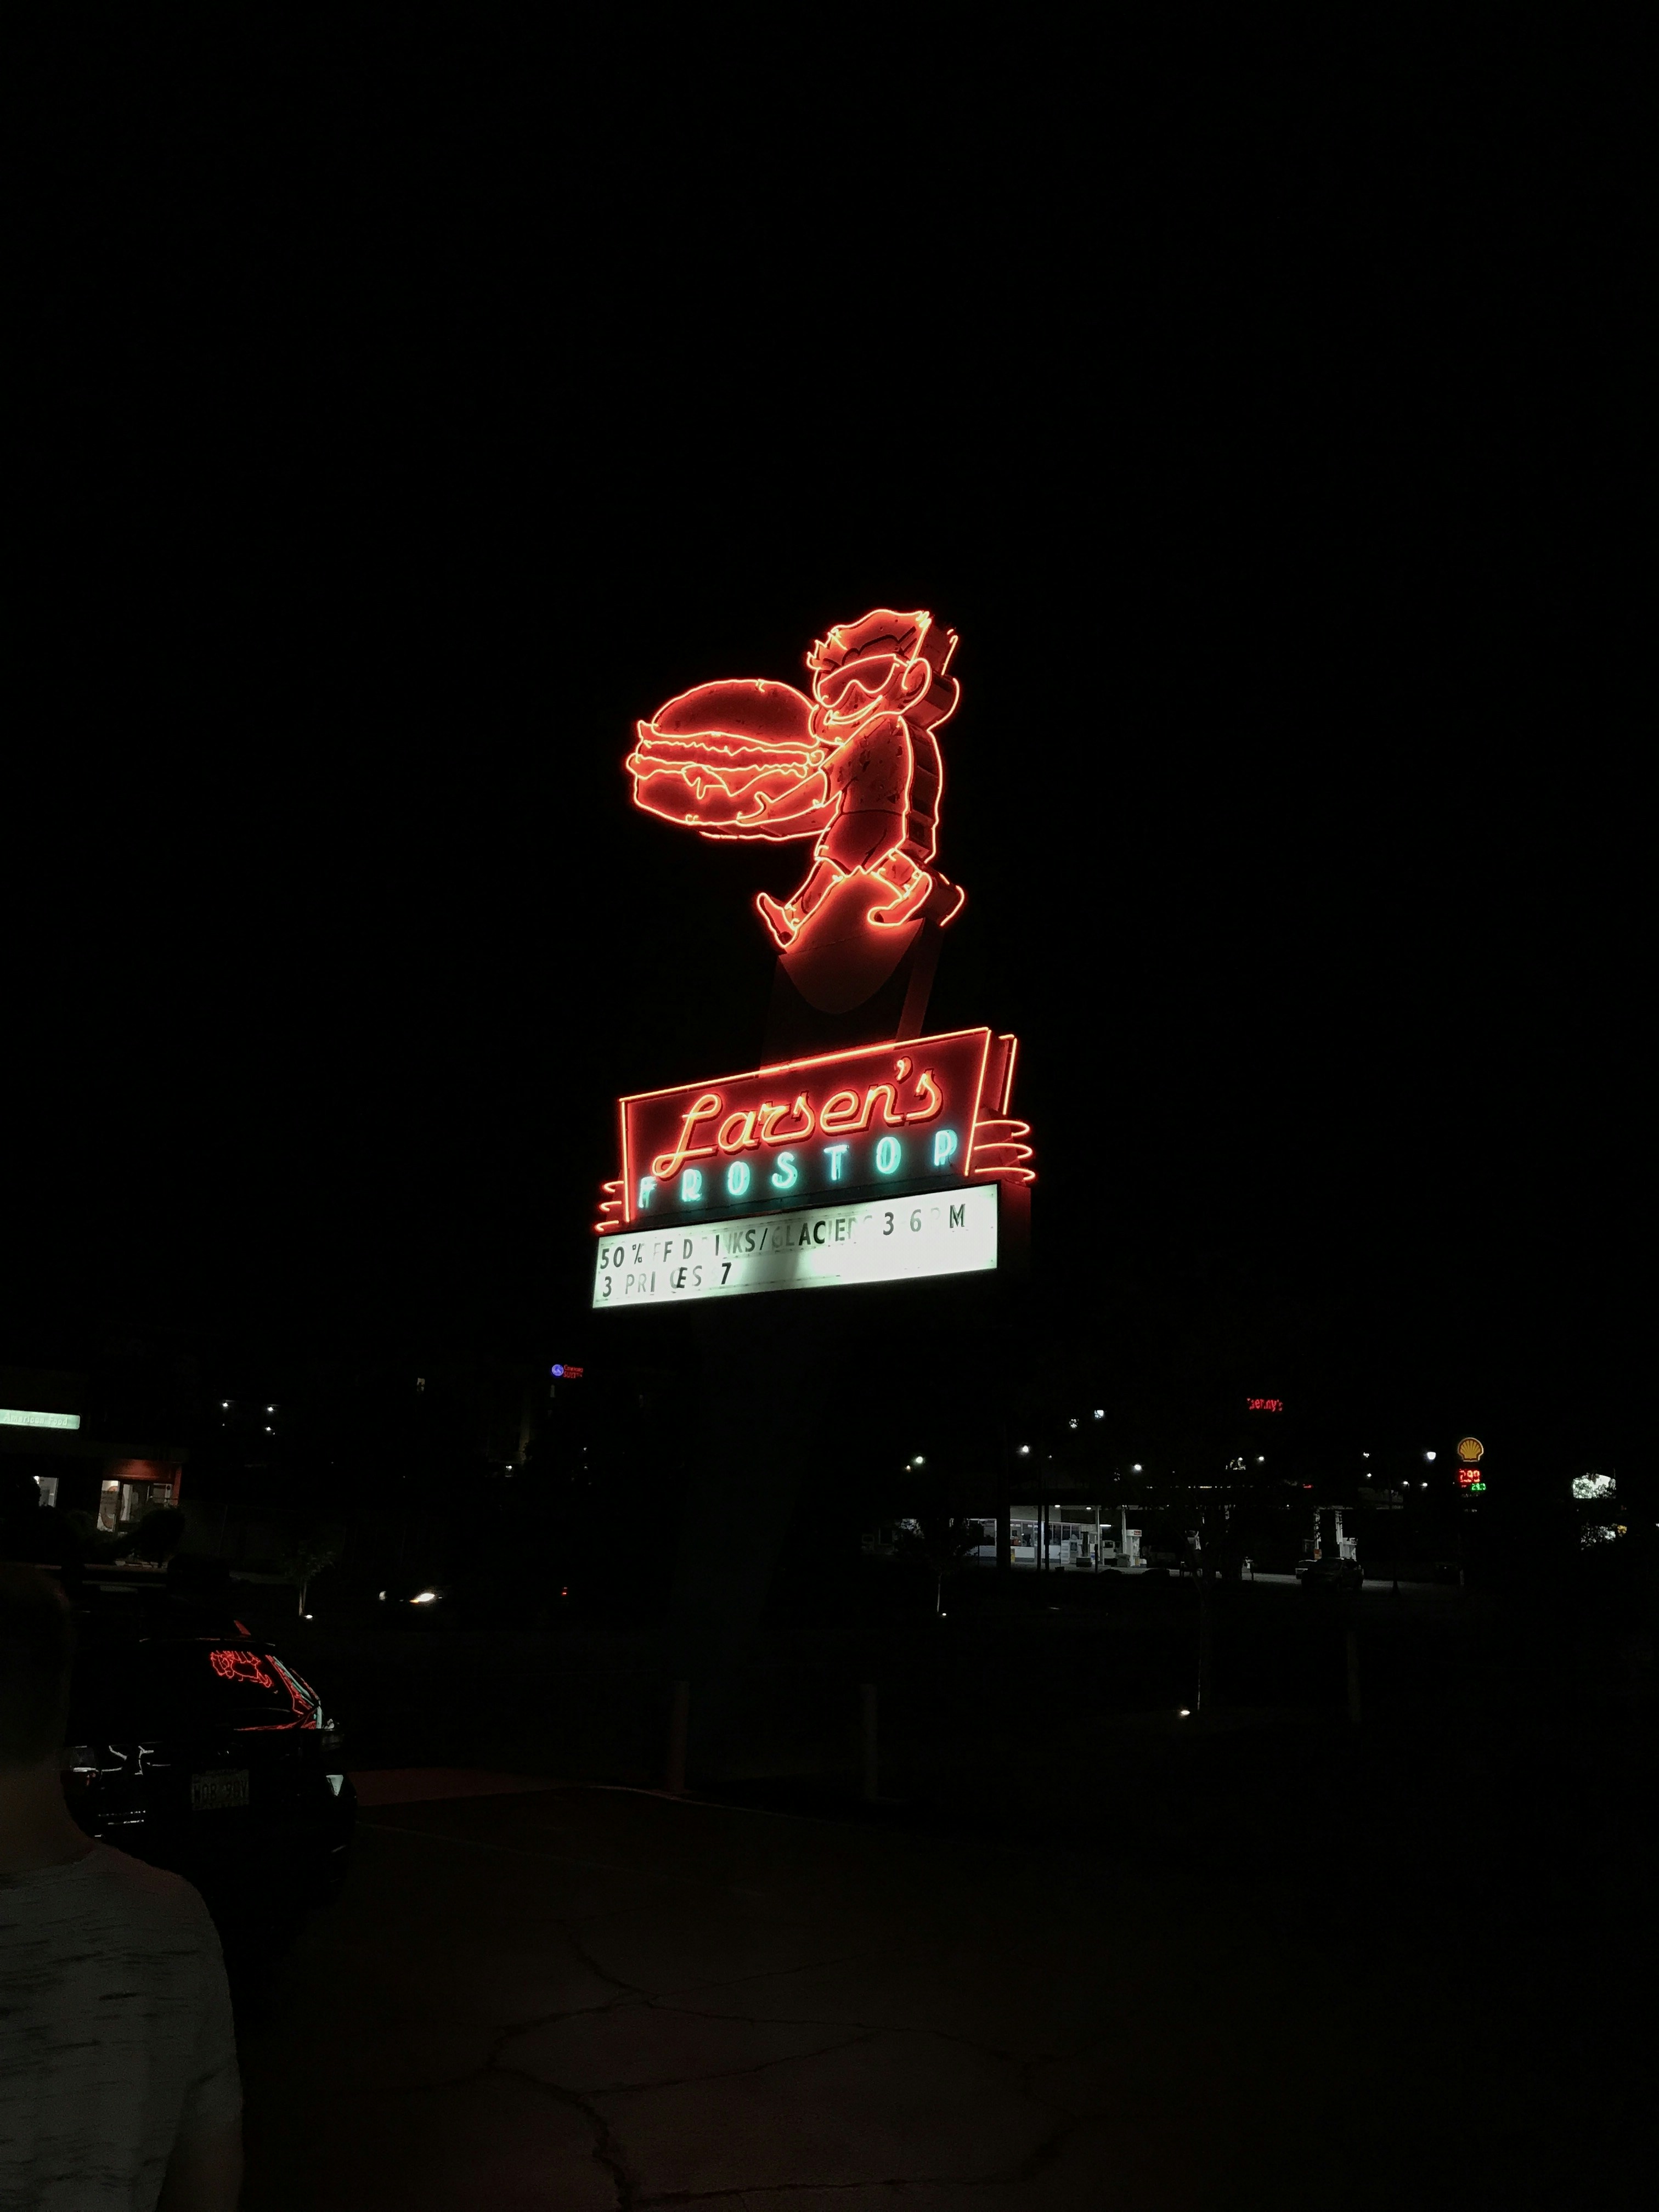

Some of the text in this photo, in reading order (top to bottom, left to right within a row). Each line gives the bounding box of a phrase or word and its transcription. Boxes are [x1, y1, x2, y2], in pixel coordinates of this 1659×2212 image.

[652, 1056, 944, 1181] Larsen's
[638, 1128, 958, 1208] FROSTOP
[600, 1243, 642, 1269] 50%
